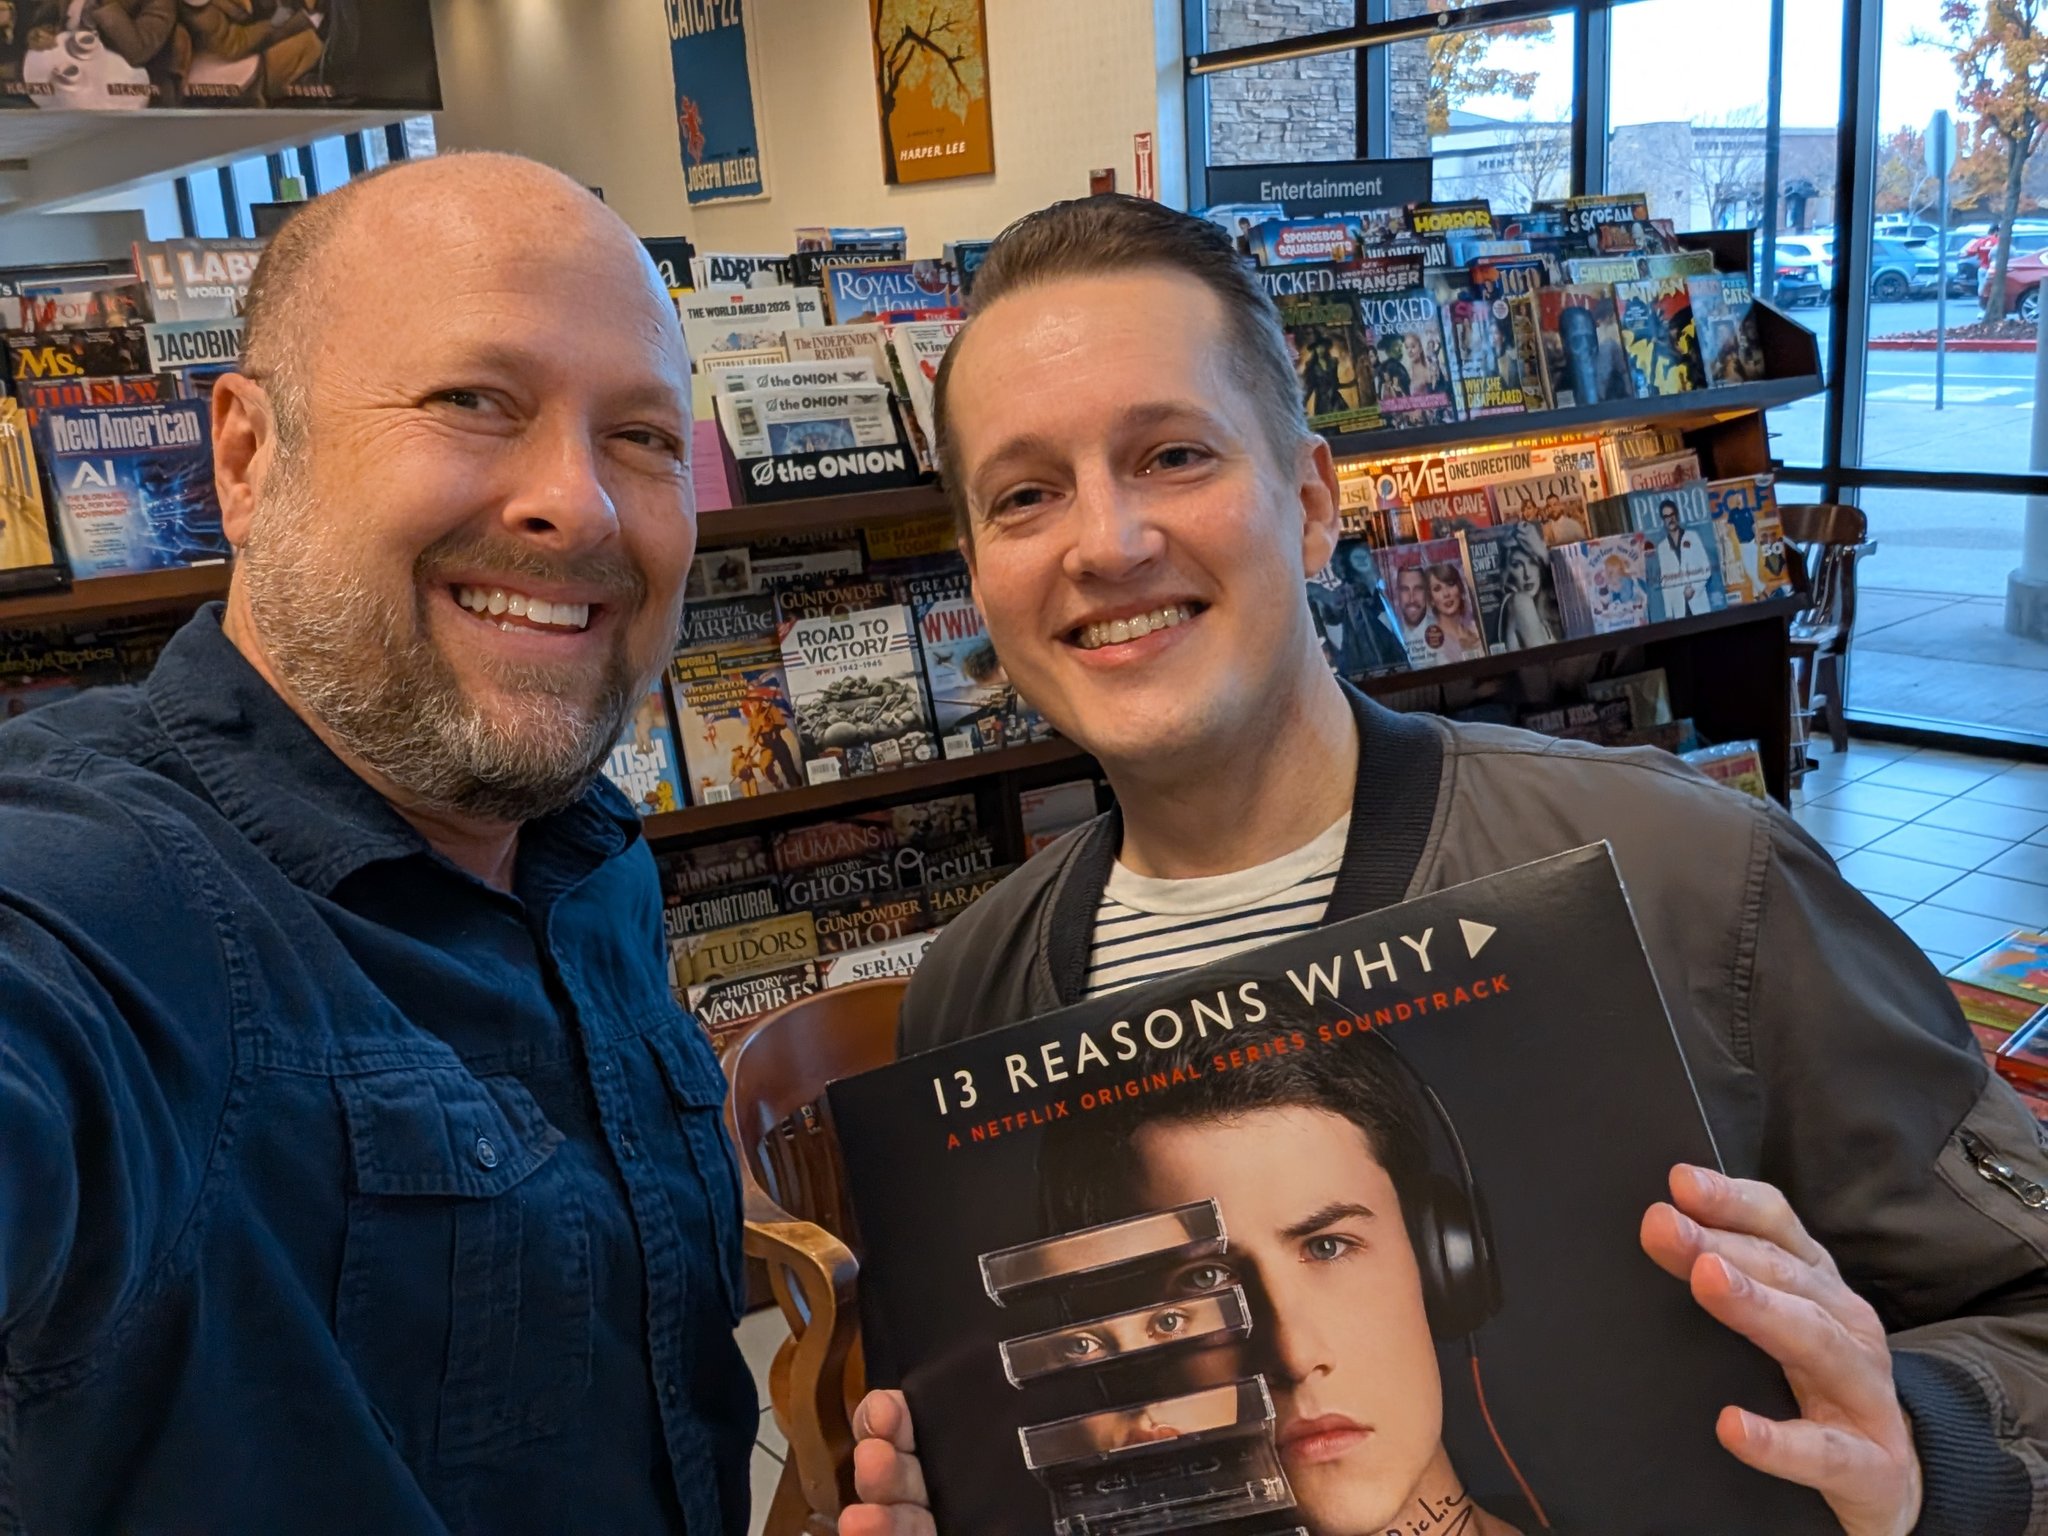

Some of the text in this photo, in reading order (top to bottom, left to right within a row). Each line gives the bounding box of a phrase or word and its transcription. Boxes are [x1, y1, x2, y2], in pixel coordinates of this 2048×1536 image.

[900, 141, 966, 161] HARPER LEE
[687, 157, 759, 192] JOSEPH HELLER
[1260, 177, 1382, 202] Entertainment
[1413, 210, 1491, 233] HORROR
[1277, 240, 1353, 256] SQUAREPANTS
[1282, 229, 1345, 244] SPONGEBOB
[185, 285, 235, 299] WORLD
[836, 271, 916, 300] ROYALS
[1620, 277, 1687, 303] BATMAN
[1722, 287, 1751, 305] CATS
[687, 301, 791, 319] THE WORLD AHEAD 2026
[872, 296, 929, 317] HOME
[1360, 297, 1434, 326] WICKED
[794, 332, 877, 350] The INDEPENDEN
[1374, 322, 1425, 336] FOR GOOD
[153, 328, 242, 362] JACOBIN
[814, 349, 856, 361] REVIEW
[15, 347, 85, 380] Ms.
[770, 372, 838, 388] the ONION
[1464, 376, 1502, 394] WHY SHE
[779, 394, 849, 411] the ONION
[1467, 389, 1523, 409] DISAPPEARED
[52, 414, 99, 452] New
[101, 409, 201, 450] American
[776, 449, 906, 484] the ONION
[1448, 463, 1471, 481] ONE
[1471, 451, 1531, 479] DIRECTION
[1553, 450, 1595, 465] GREAT
[71, 460, 117, 489] AI
[1631, 463, 1696, 491] Guitarist
[1500, 473, 1579, 508] TAYLOR
[1708, 485, 1770, 520] GOLF
[1413, 492, 1487, 521] NICK CAVE
[1470, 541, 1499, 558] TAYLOR
[1471, 555, 1498, 573] SWIFT
[779, 582, 887, 610] GUNPOWDER
[909, 574, 969, 594] GREATE
[678, 609, 775, 641] WARFARE
[690, 604, 748, 621] MEDIEVAL
[796, 618, 889, 648] ROAD TO
[677, 653, 716, 667] WORLD
[803, 635, 888, 665] VICTORY
[694, 664, 719, 678] WAR
[814, 659, 882, 676] WW2 1942-1945
[683, 679, 748, 695] OPERATION
[687, 688, 748, 705] IRONCLAD
[783, 824, 881, 866] HUMANS
[815, 858, 862, 878] HISTORY
[790, 863, 894, 906] GHOSTS
[663, 887, 780, 937] SUPERNATURAL
[815, 899, 923, 936] GUNPOWDER
[838, 917, 908, 950] PLOT
[700, 926, 808, 970] TUDORS
[852, 952, 917, 979] SERIAL
[726, 974, 783, 1000] HISTORY
[698, 979, 817, 1026] VAMPIRES
[933, 927, 1439, 1117] 13 REASONS WHY
[945, 972, 1511, 1150] A NETFLIX ORIGINAL SERIES SOUNDTRACK
